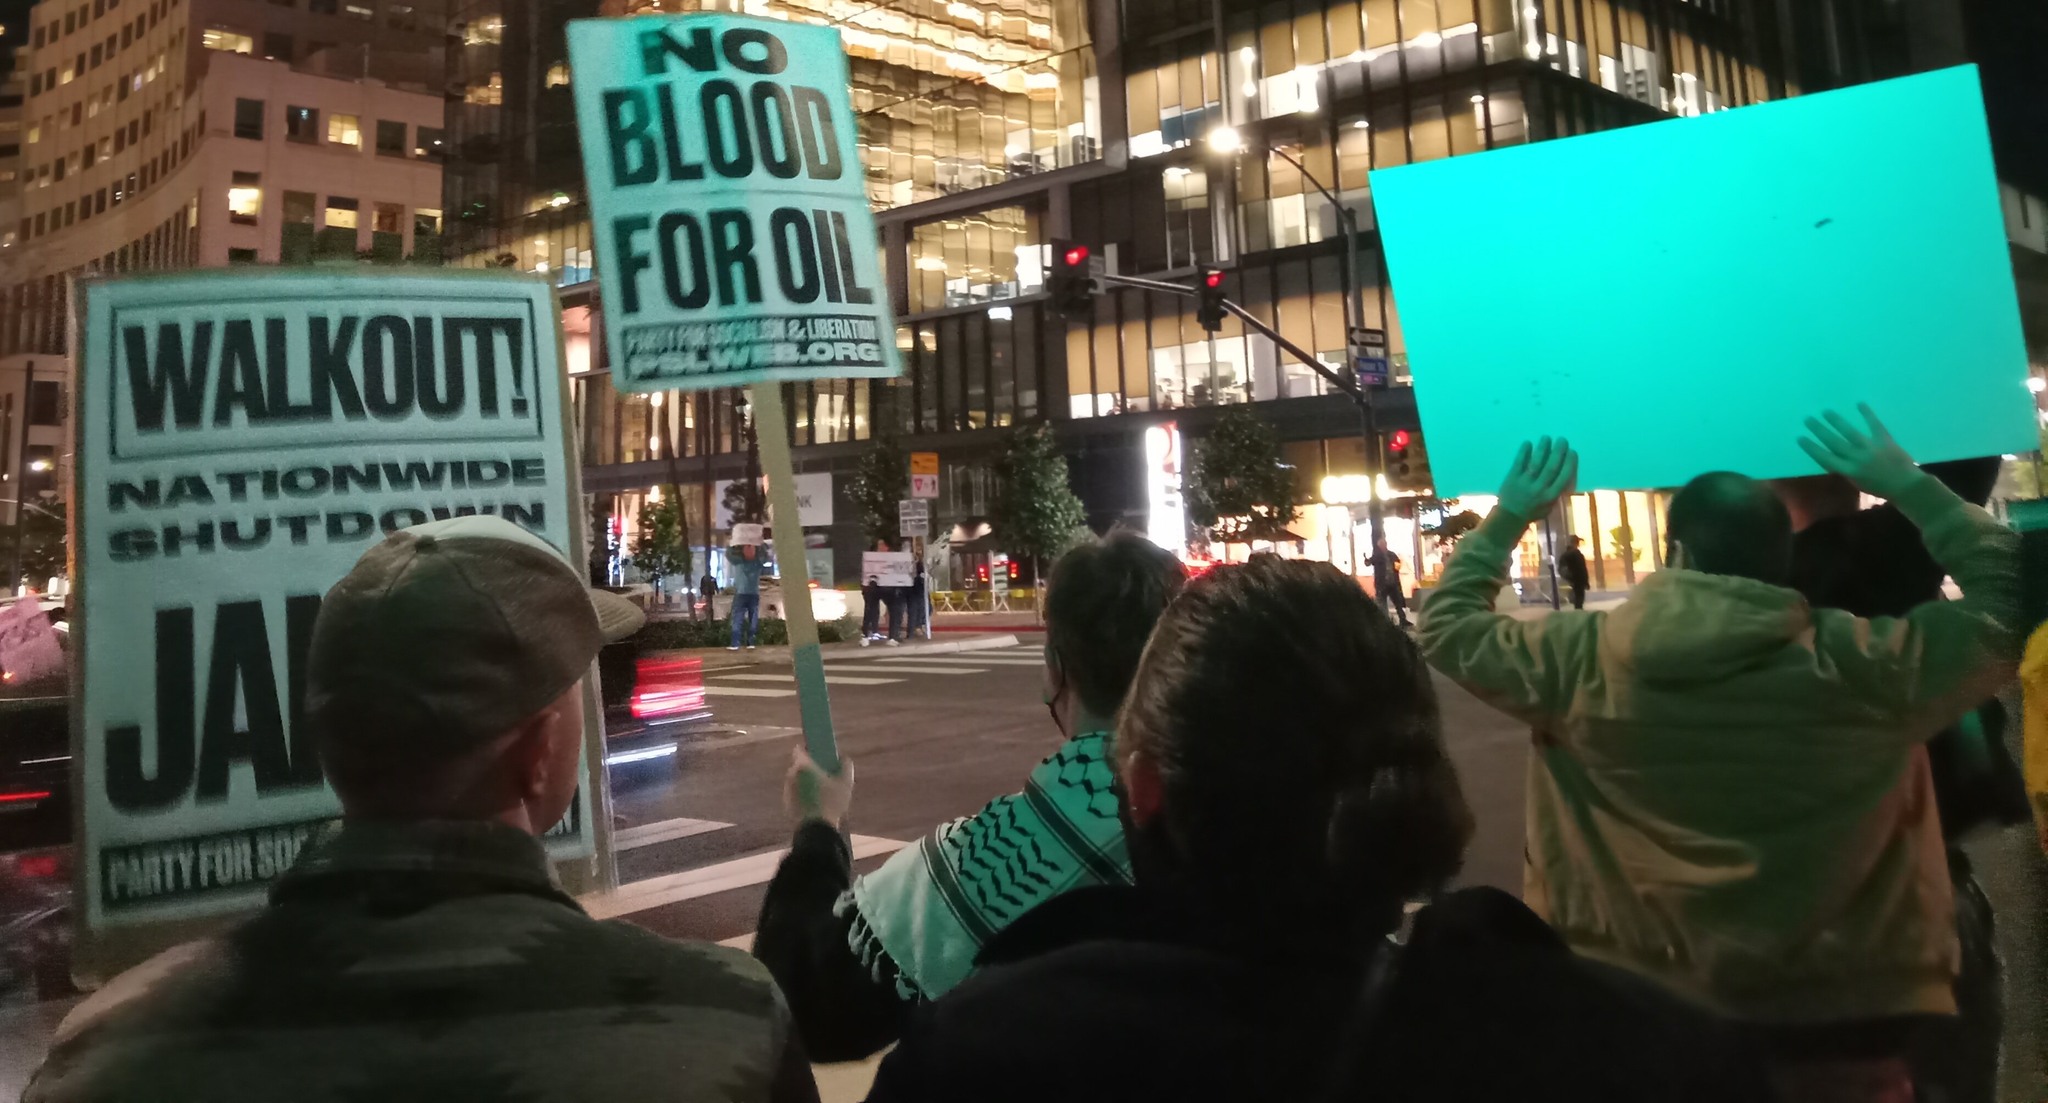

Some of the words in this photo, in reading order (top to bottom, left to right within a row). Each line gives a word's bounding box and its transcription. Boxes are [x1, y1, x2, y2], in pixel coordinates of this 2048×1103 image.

[640, 27, 788, 75] NO
[602, 78, 843, 188] BLOOD
[612, 208, 762, 315] FOR
[769, 206, 873, 305] OIL
[788, 319, 806, 341] &
[807, 318, 876, 341] LIBERATION
[123, 314, 529, 435] WALKOUT!
[107, 458, 546, 513] NATIONWIDE
[198, 837, 253, 888] FOR
